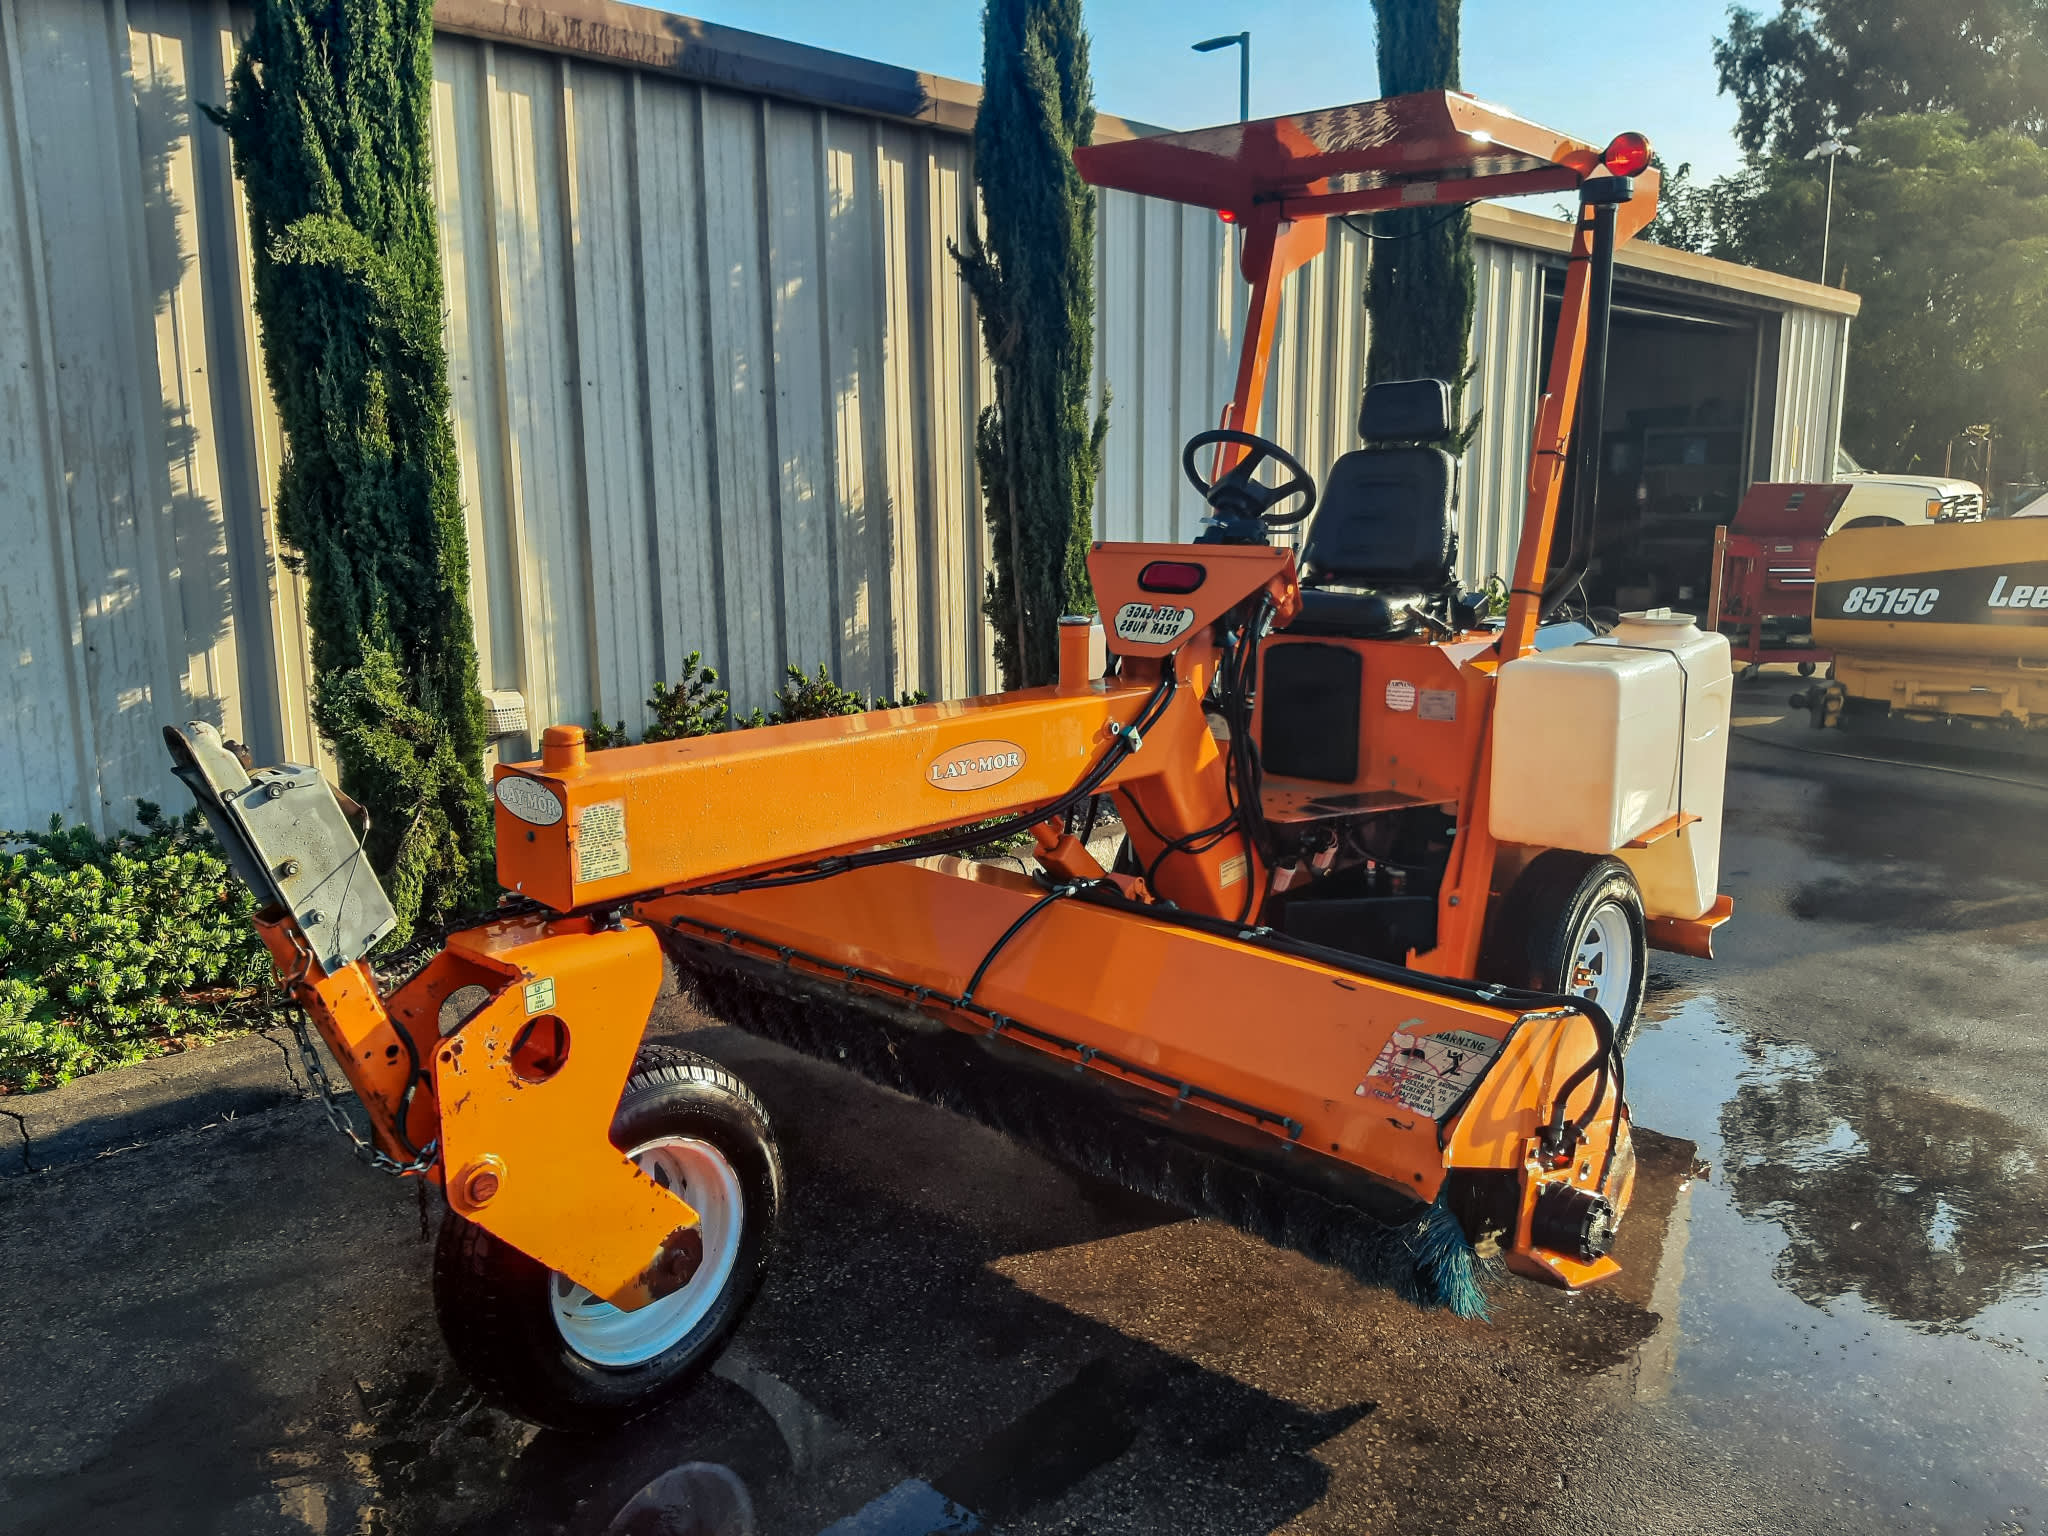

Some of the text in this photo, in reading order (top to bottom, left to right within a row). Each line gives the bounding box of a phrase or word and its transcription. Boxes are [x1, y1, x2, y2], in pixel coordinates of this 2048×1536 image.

[1842, 586, 1940, 615] 8515C
[1987, 575, 2048, 608] Lee
[1436, 1032, 1486, 1051] WARNING
